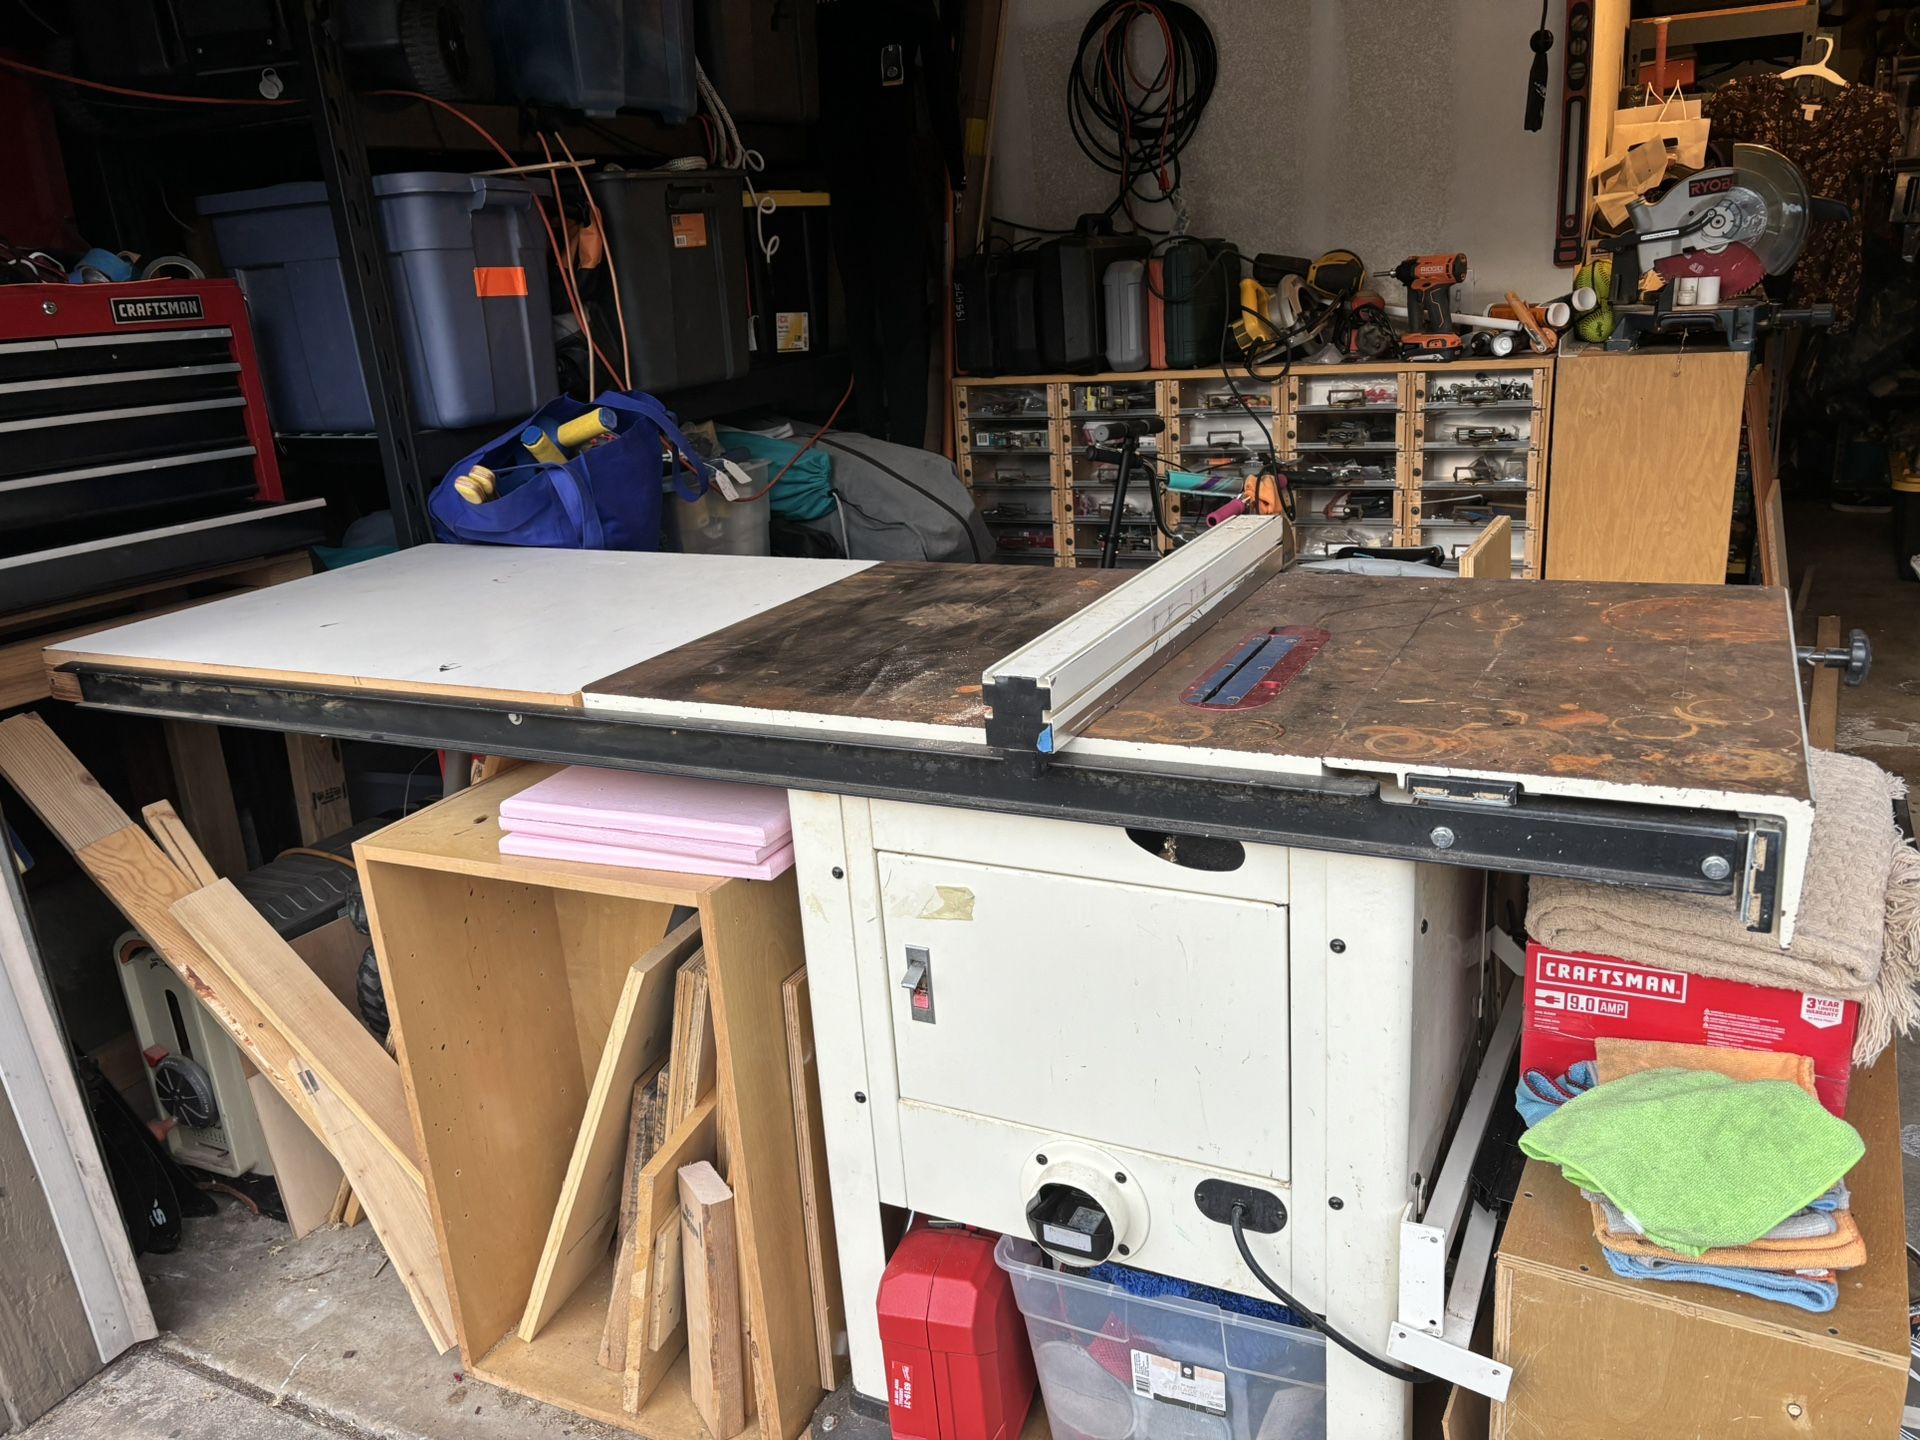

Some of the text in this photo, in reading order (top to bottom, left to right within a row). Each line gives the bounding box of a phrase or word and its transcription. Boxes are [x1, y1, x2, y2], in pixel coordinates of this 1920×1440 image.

[118, 300, 198, 317] CRAFTSMAN
[1546, 962, 1676, 995] CRAFTSMAN
[1570, 995, 1624, 1015] 9.0 AMP
[1806, 997, 1839, 1009] 3 YEAR
[1806, 1009, 1839, 1017] WARRANTY
